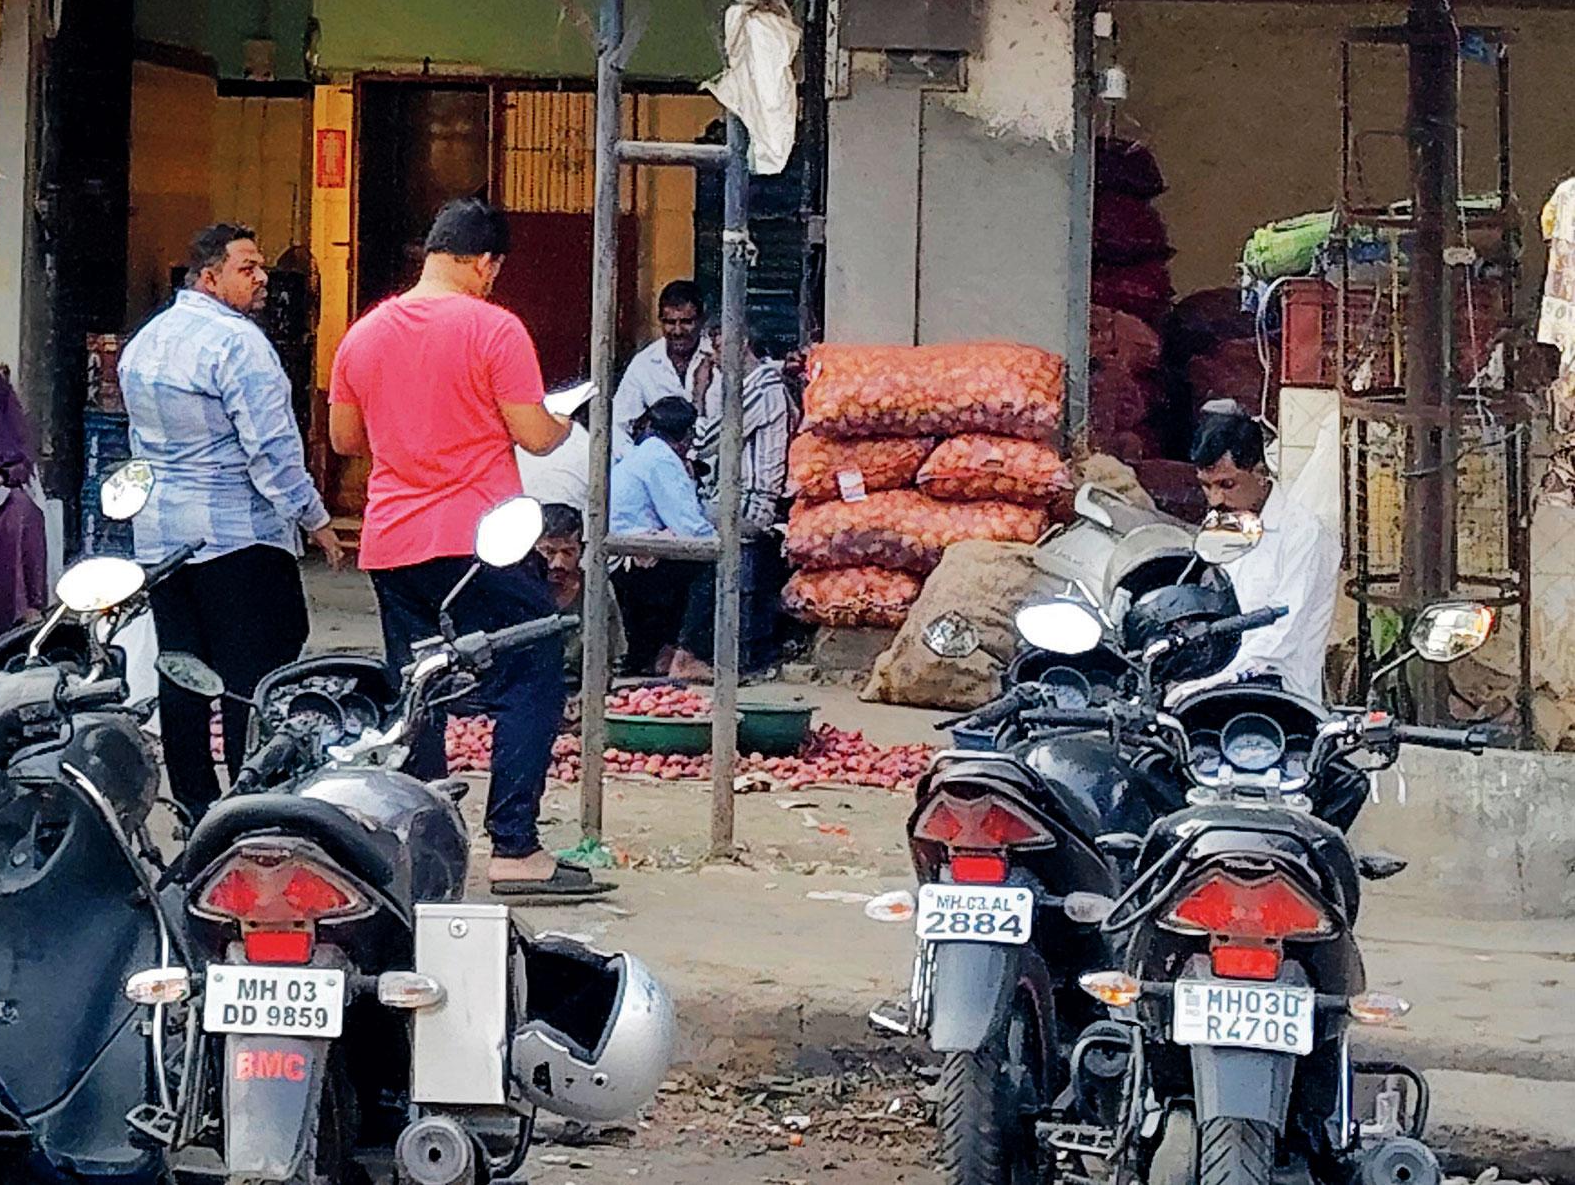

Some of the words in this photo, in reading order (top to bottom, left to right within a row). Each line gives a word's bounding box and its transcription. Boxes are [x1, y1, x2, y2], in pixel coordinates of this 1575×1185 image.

[924, 911, 1023, 937] 2884
[237, 978, 278, 1001] MH
[287, 980, 317, 1002] 03
[1207, 989, 1300, 1018] MH03D
[223, 1004, 258, 1026] DD
[267, 1005, 329, 1029] 9859
[1207, 1015, 1299, 1046] R4706
[236, 1050, 306, 1082] BMC
